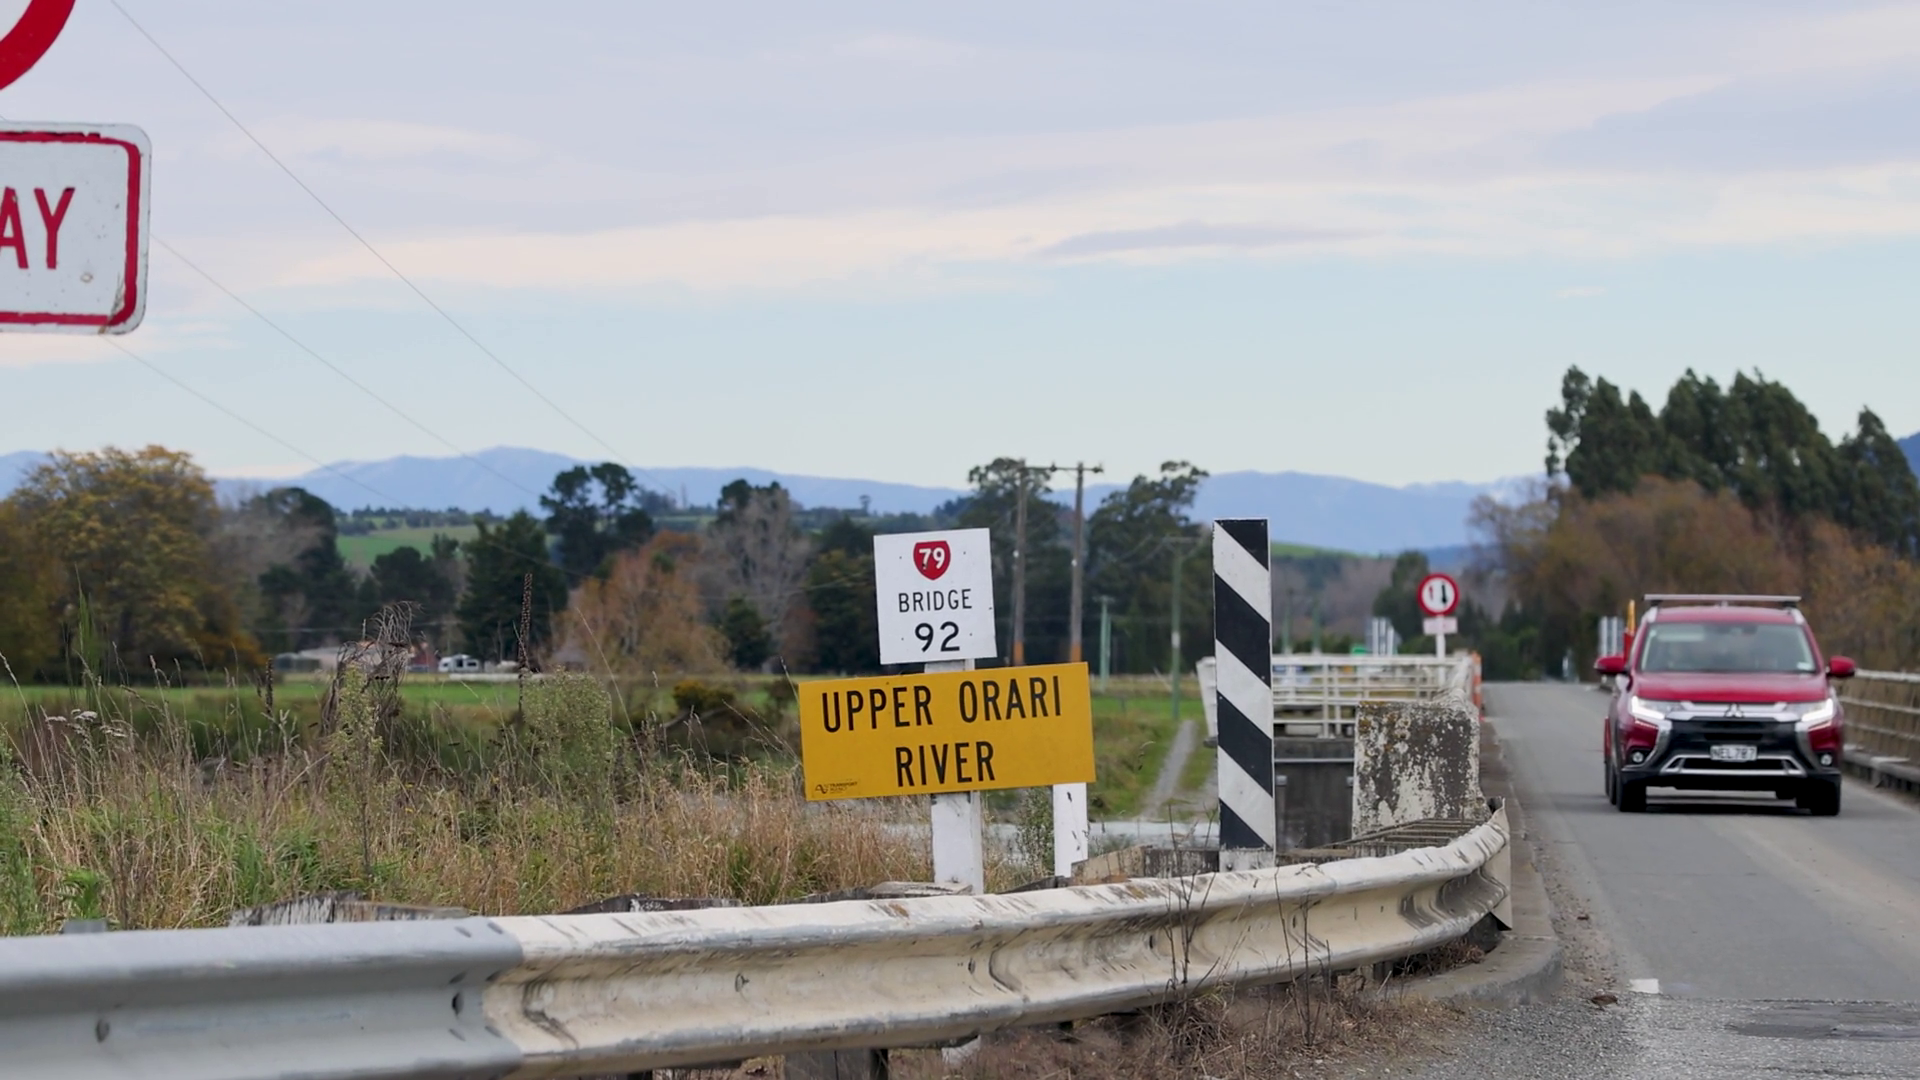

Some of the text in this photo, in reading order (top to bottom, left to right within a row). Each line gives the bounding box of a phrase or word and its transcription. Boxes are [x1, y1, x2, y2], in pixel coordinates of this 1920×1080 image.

[918, 547, 946, 570] 79
[898, 588, 973, 613] BRIDGE
[914, 621, 961, 653] 92
[822, 675, 1062, 733] UPPER ORARI
[895, 741, 996, 788] RIVER
